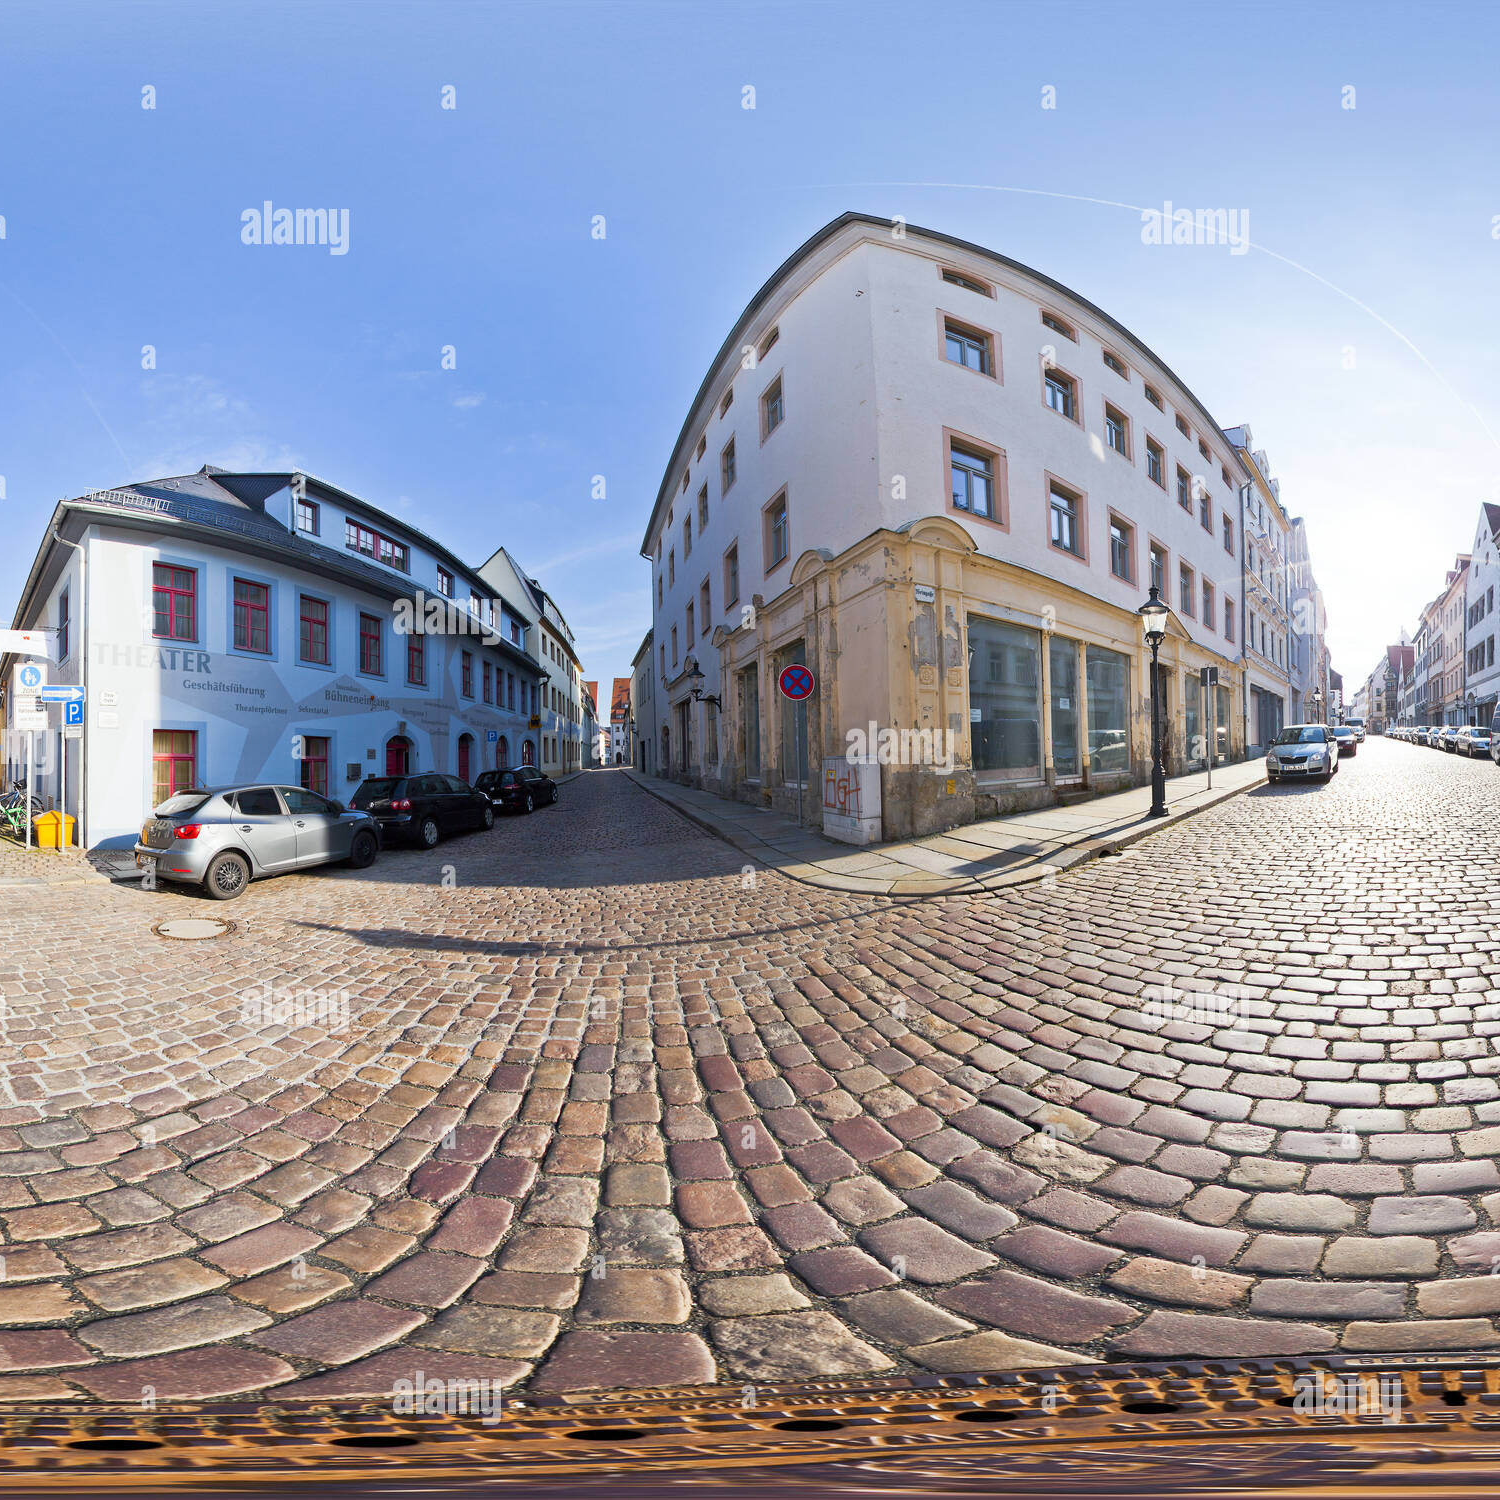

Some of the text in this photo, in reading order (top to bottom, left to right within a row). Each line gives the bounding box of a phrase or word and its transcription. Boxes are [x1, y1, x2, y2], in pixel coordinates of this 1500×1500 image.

[94, 642, 212, 674] THEATER
[182, 679, 266, 699] Geschäftsführung
[324, 689, 390, 711] Bühneneingang
[69, 703, 79, 722] P
[589, 1389, 717, 1402] KANAL
